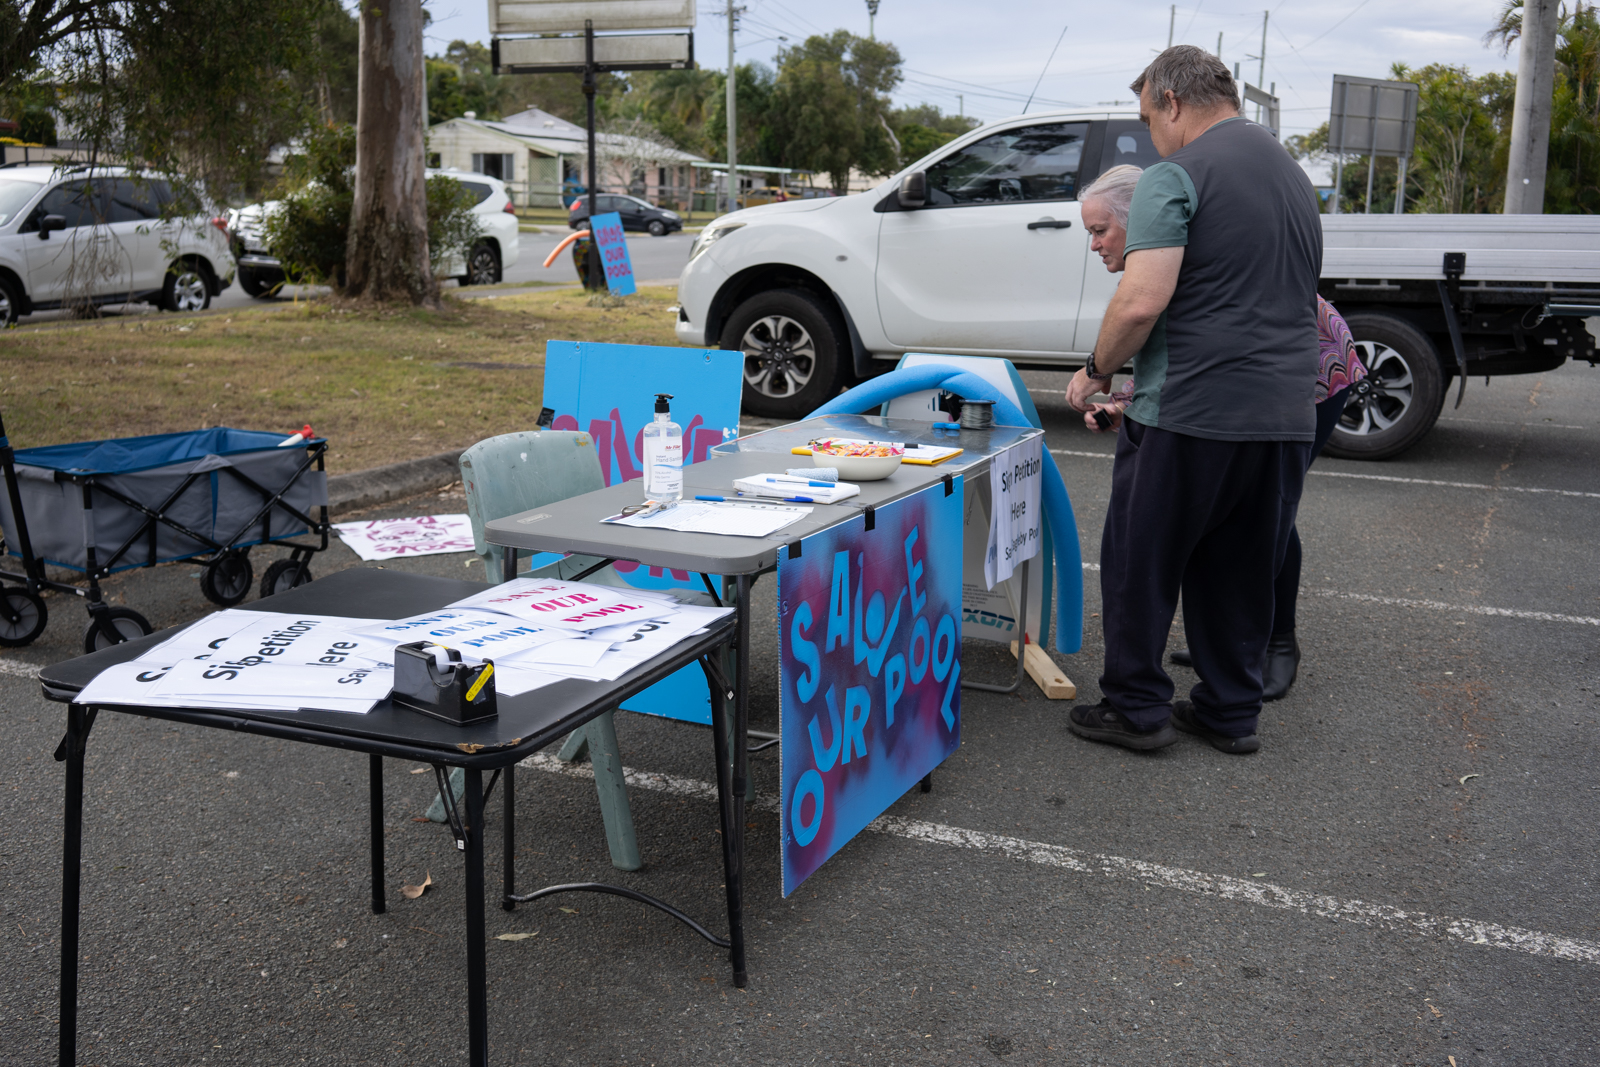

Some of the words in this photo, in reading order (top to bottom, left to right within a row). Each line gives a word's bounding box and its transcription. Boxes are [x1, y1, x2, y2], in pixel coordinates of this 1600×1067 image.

[605, 246, 625, 262] OUR
[607, 262, 632, 279] POOL
[1014, 457, 1041, 484] Petition
[1011, 501, 1026, 522] Here
[488, 585, 566, 604] SAVE
[531, 593, 598, 612] OUR
[385, 613, 464, 631] SAVE
[561, 603, 644, 623] POOL
[429, 620, 497, 637] OUR
[461, 626, 544, 647] POOL
[305, 642, 358, 667] ere
[791, 683, 871, 847] OUR
[885, 614, 961, 732] POOL
